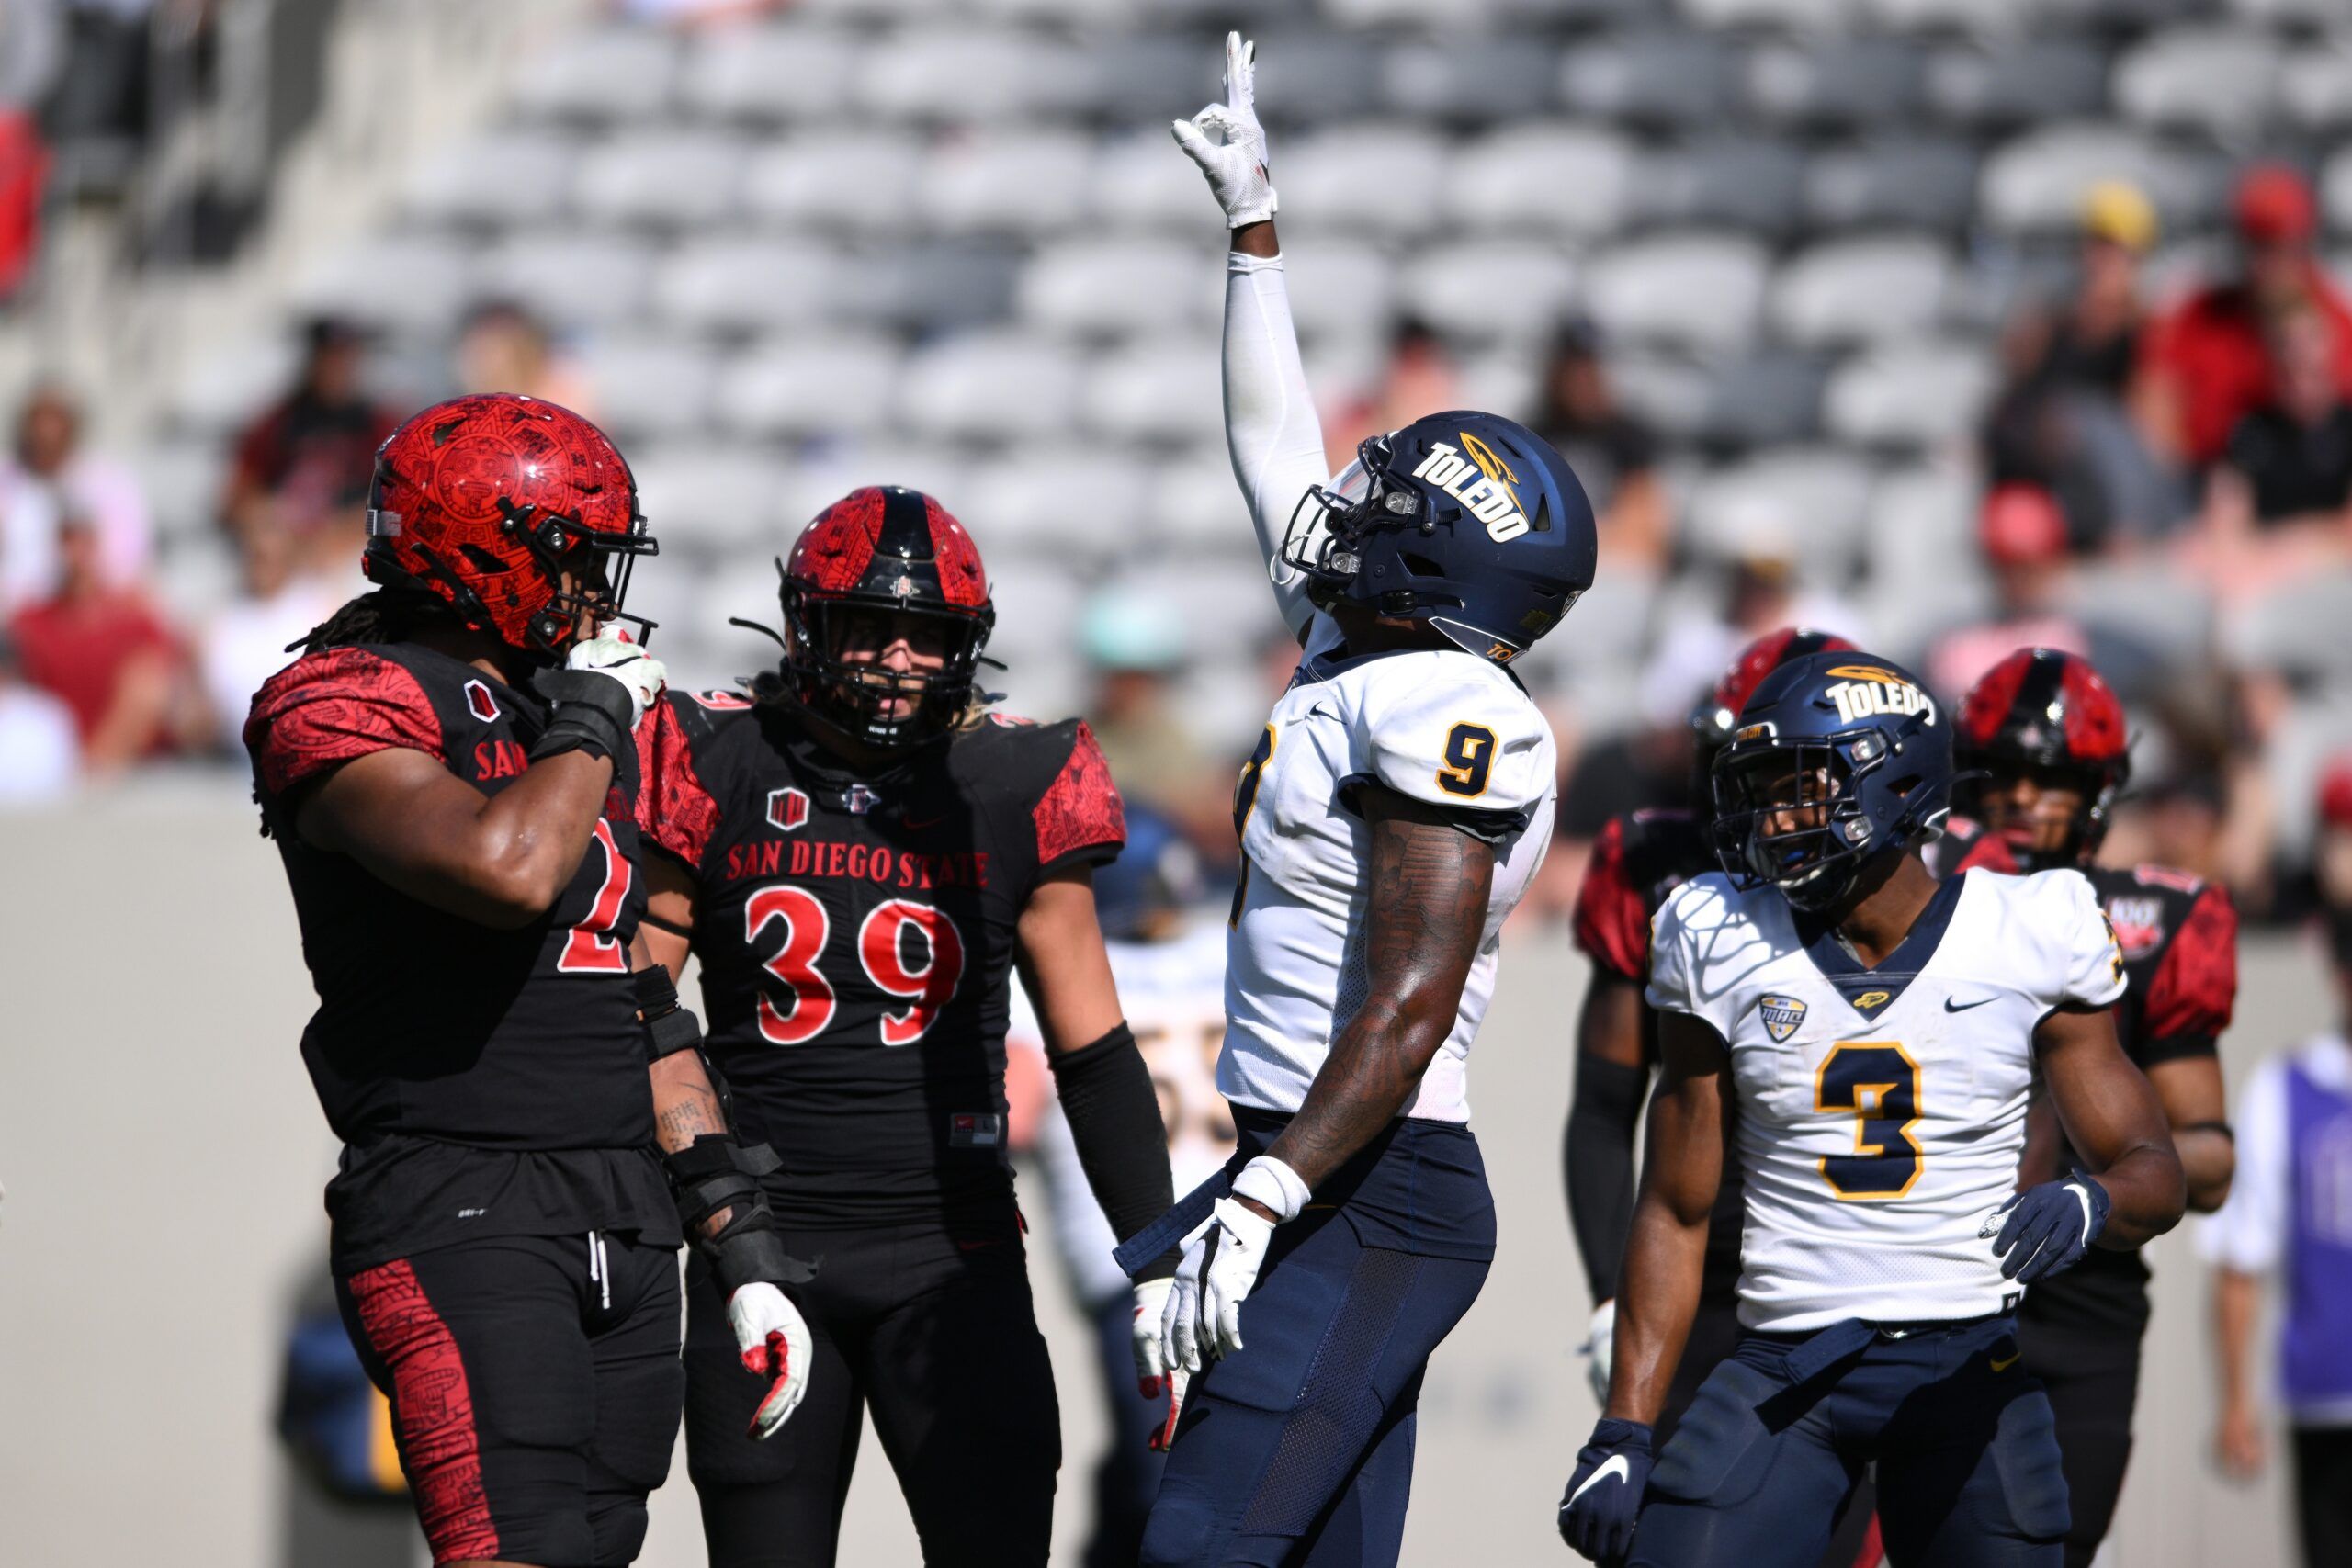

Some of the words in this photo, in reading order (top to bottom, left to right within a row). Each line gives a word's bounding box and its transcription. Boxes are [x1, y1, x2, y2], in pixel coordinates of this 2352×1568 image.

[1412, 442, 1530, 543] TOLEDO
[1826, 681, 1936, 726] TOLEDO
[1434, 720, 1499, 800] 9
[557, 817, 631, 973] 2
[726, 840, 781, 879] SAN
[788, 840, 891, 882] DIEGO
[898, 852, 989, 890] STATE
[745, 885, 965, 1046] 39
[1814, 1042, 1923, 1200] 3
